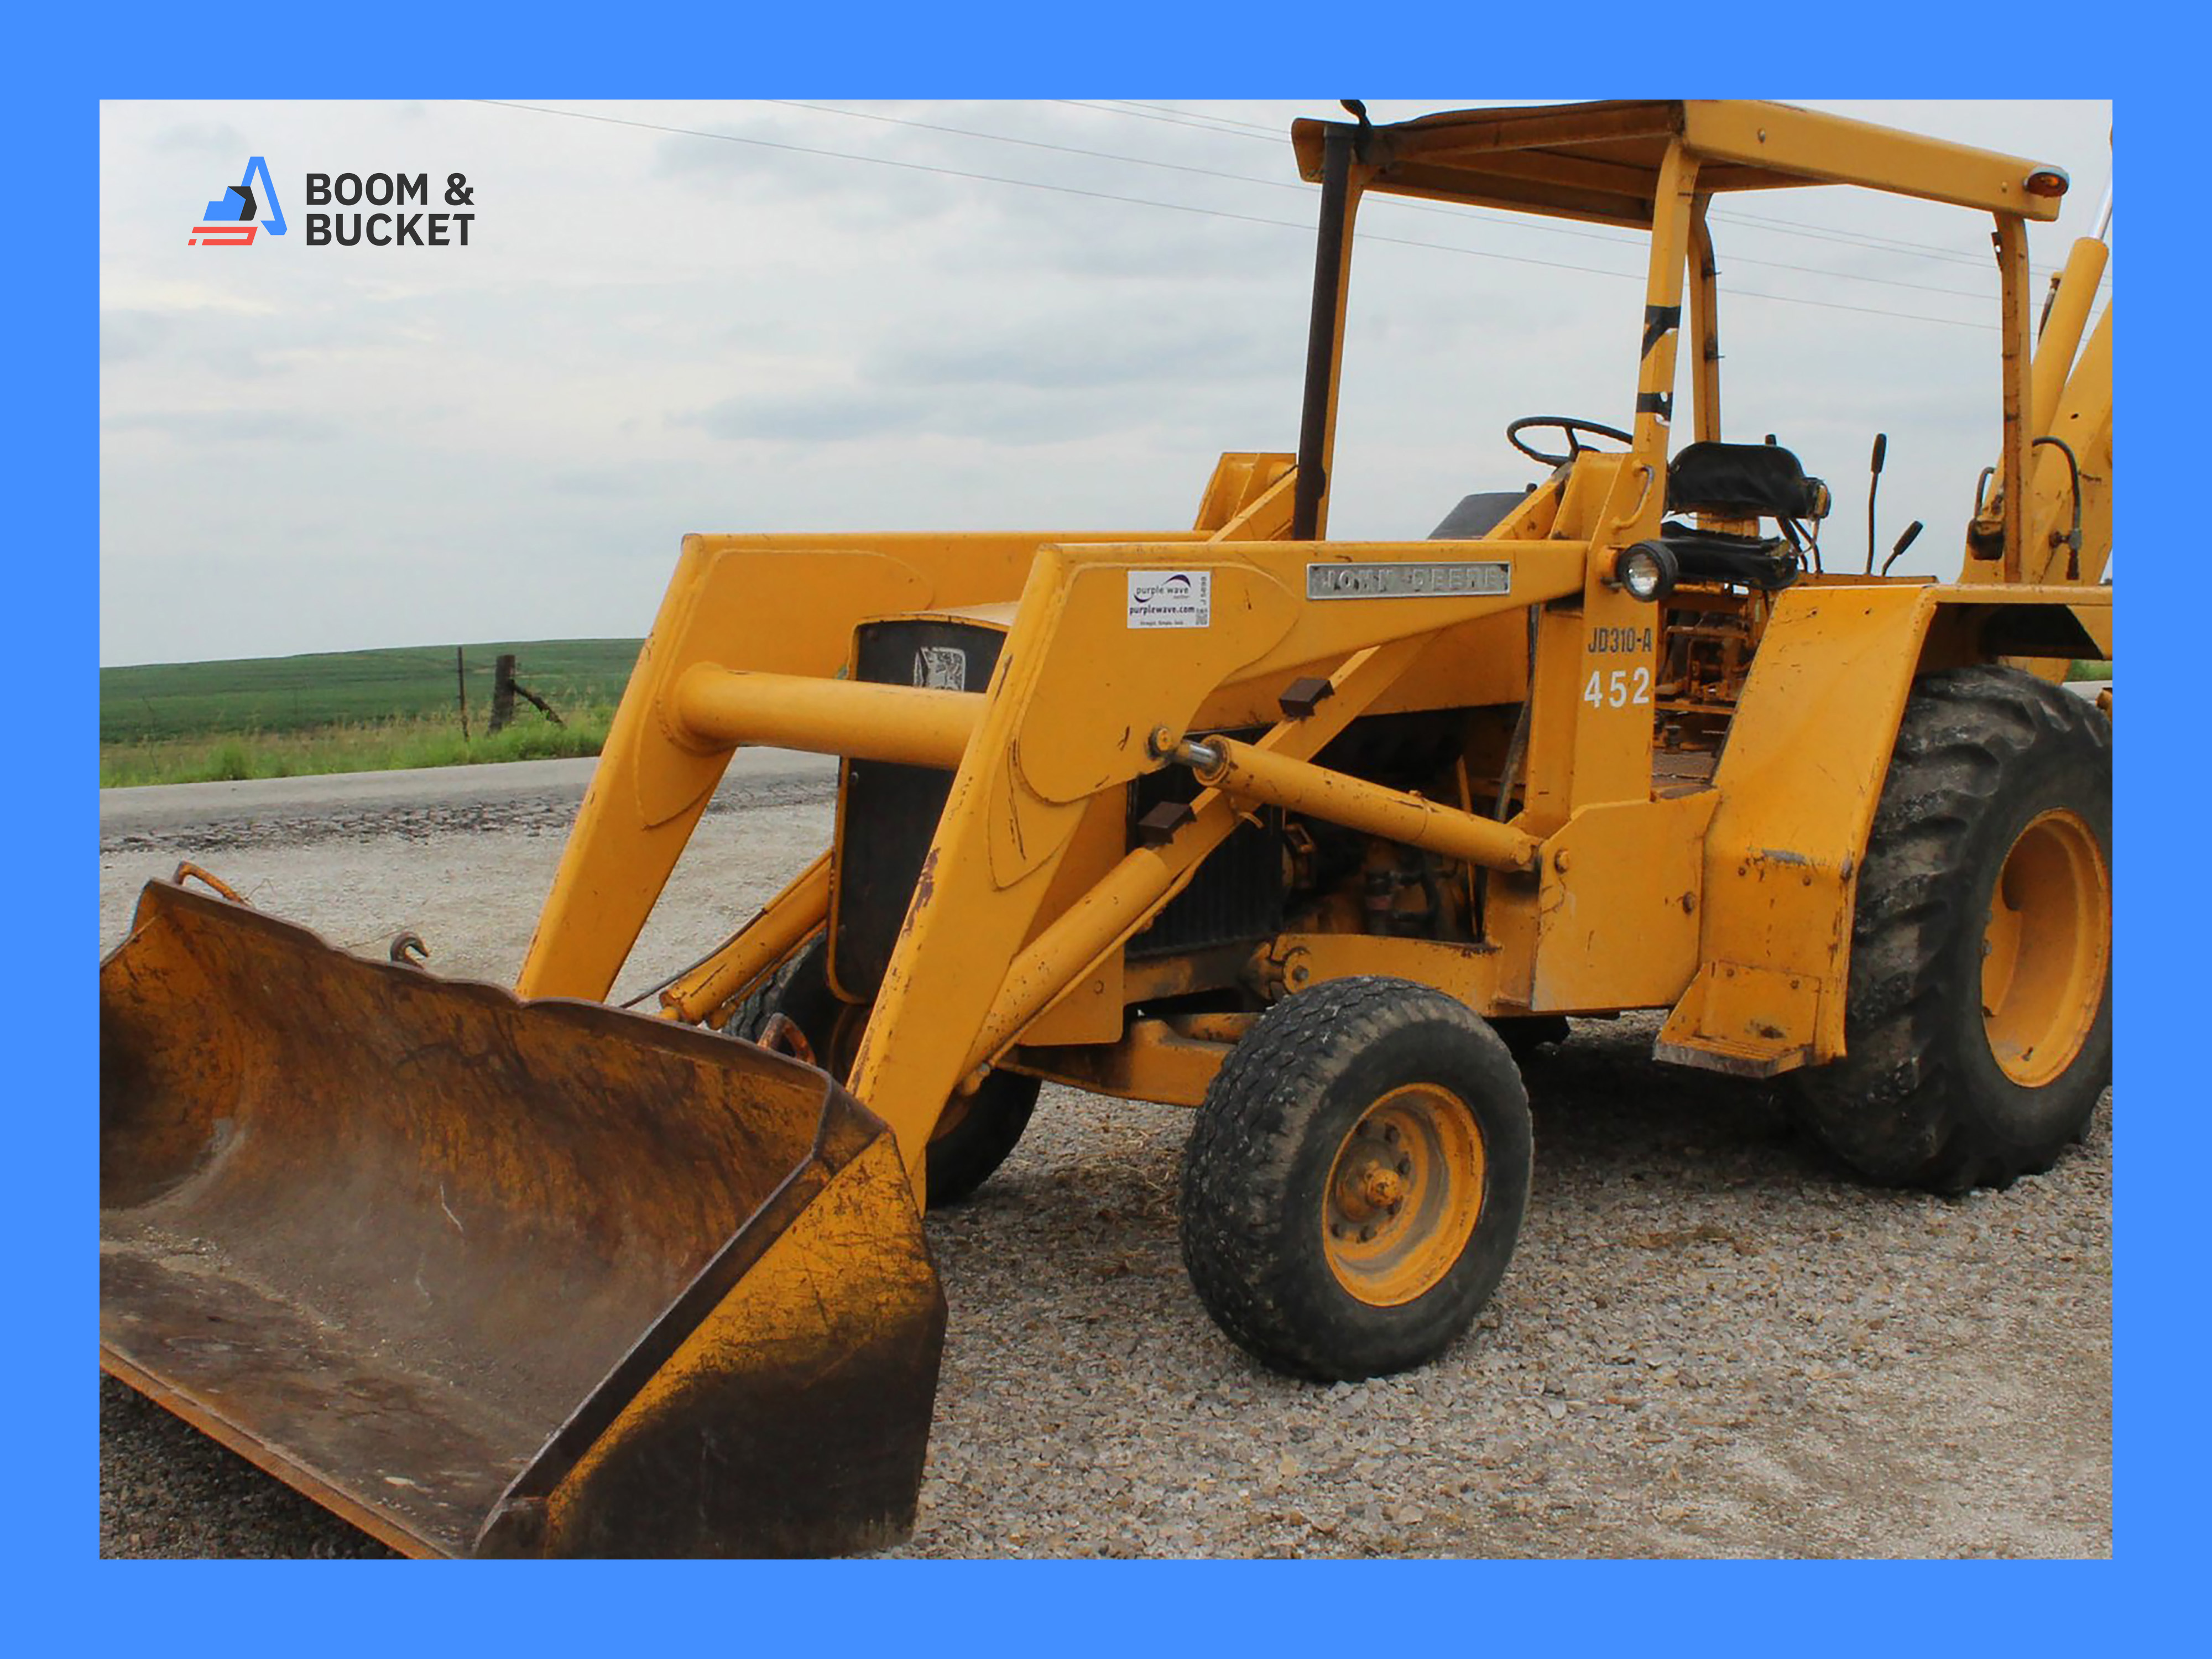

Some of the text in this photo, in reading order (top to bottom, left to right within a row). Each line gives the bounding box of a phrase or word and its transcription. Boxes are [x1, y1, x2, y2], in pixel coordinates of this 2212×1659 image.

[1136, 585, 1164, 595] purple
[1129, 604, 1195, 616] purplewave.com
[1588, 628, 1652, 653] JD310-A
[1584, 666, 1650, 709] 452
